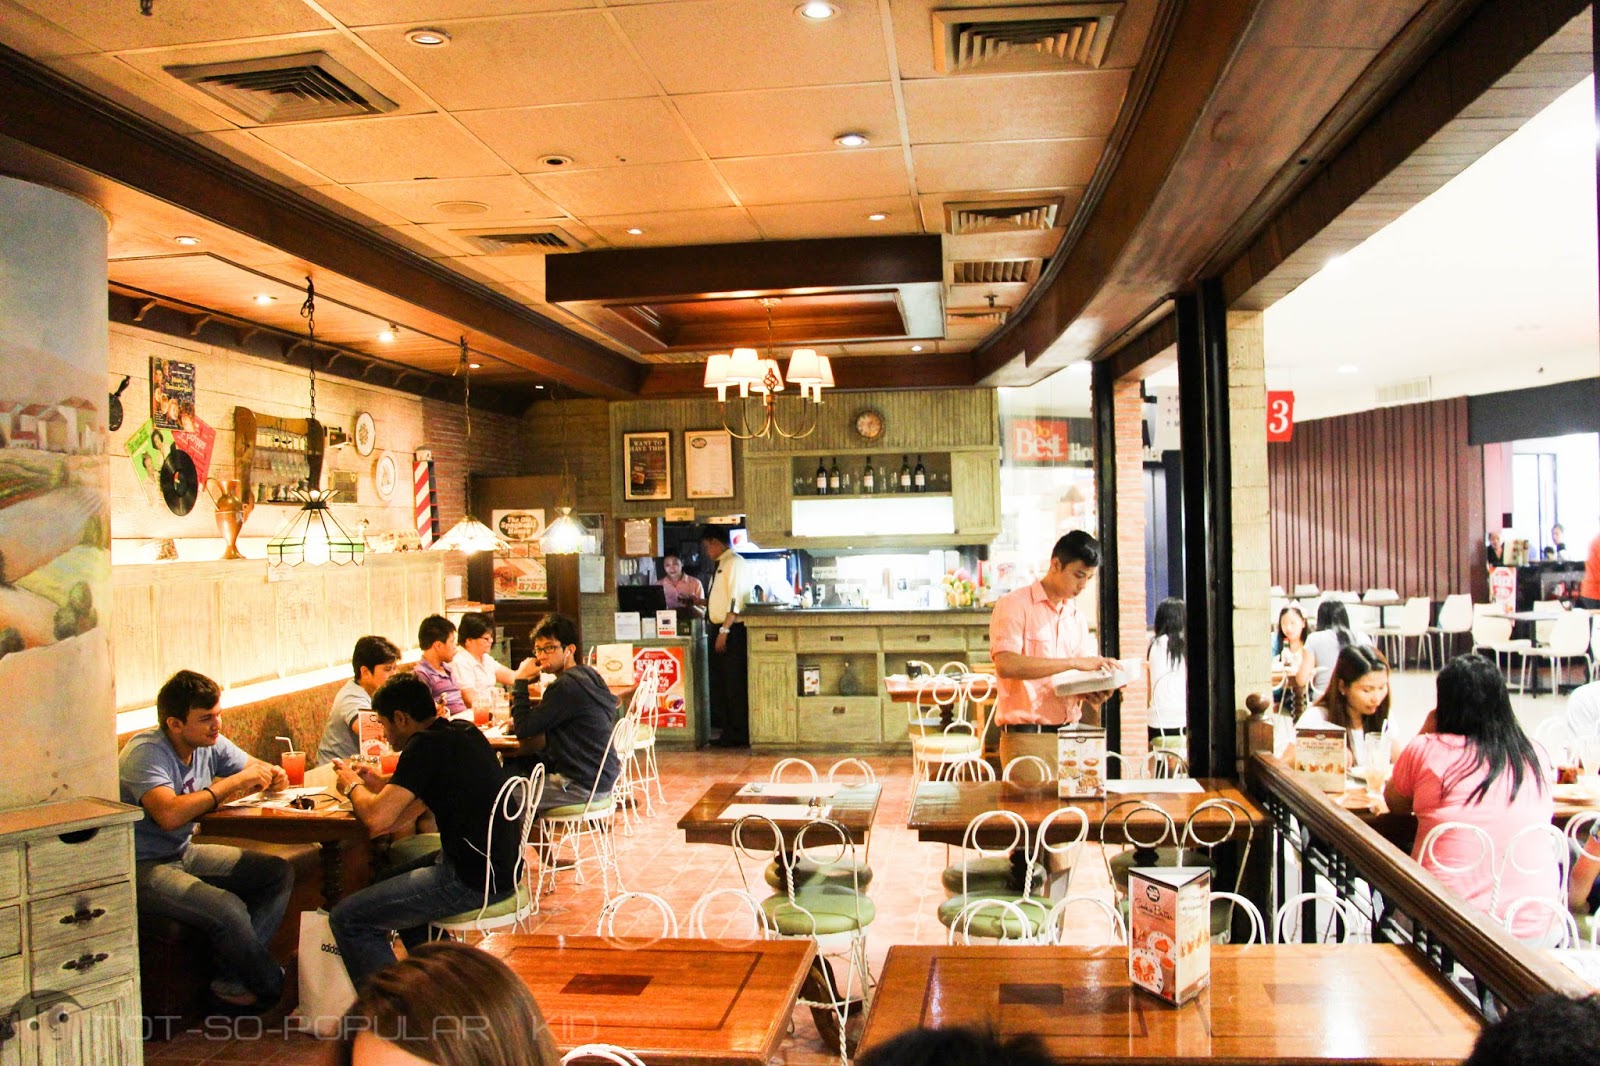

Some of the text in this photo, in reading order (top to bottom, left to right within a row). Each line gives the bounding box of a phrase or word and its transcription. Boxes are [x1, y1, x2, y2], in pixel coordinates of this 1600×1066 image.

[1269, 400, 1289, 434] 3
[1015, 428, 1093, 460] Best Ho
[636, 663, 674, 674] SLE
